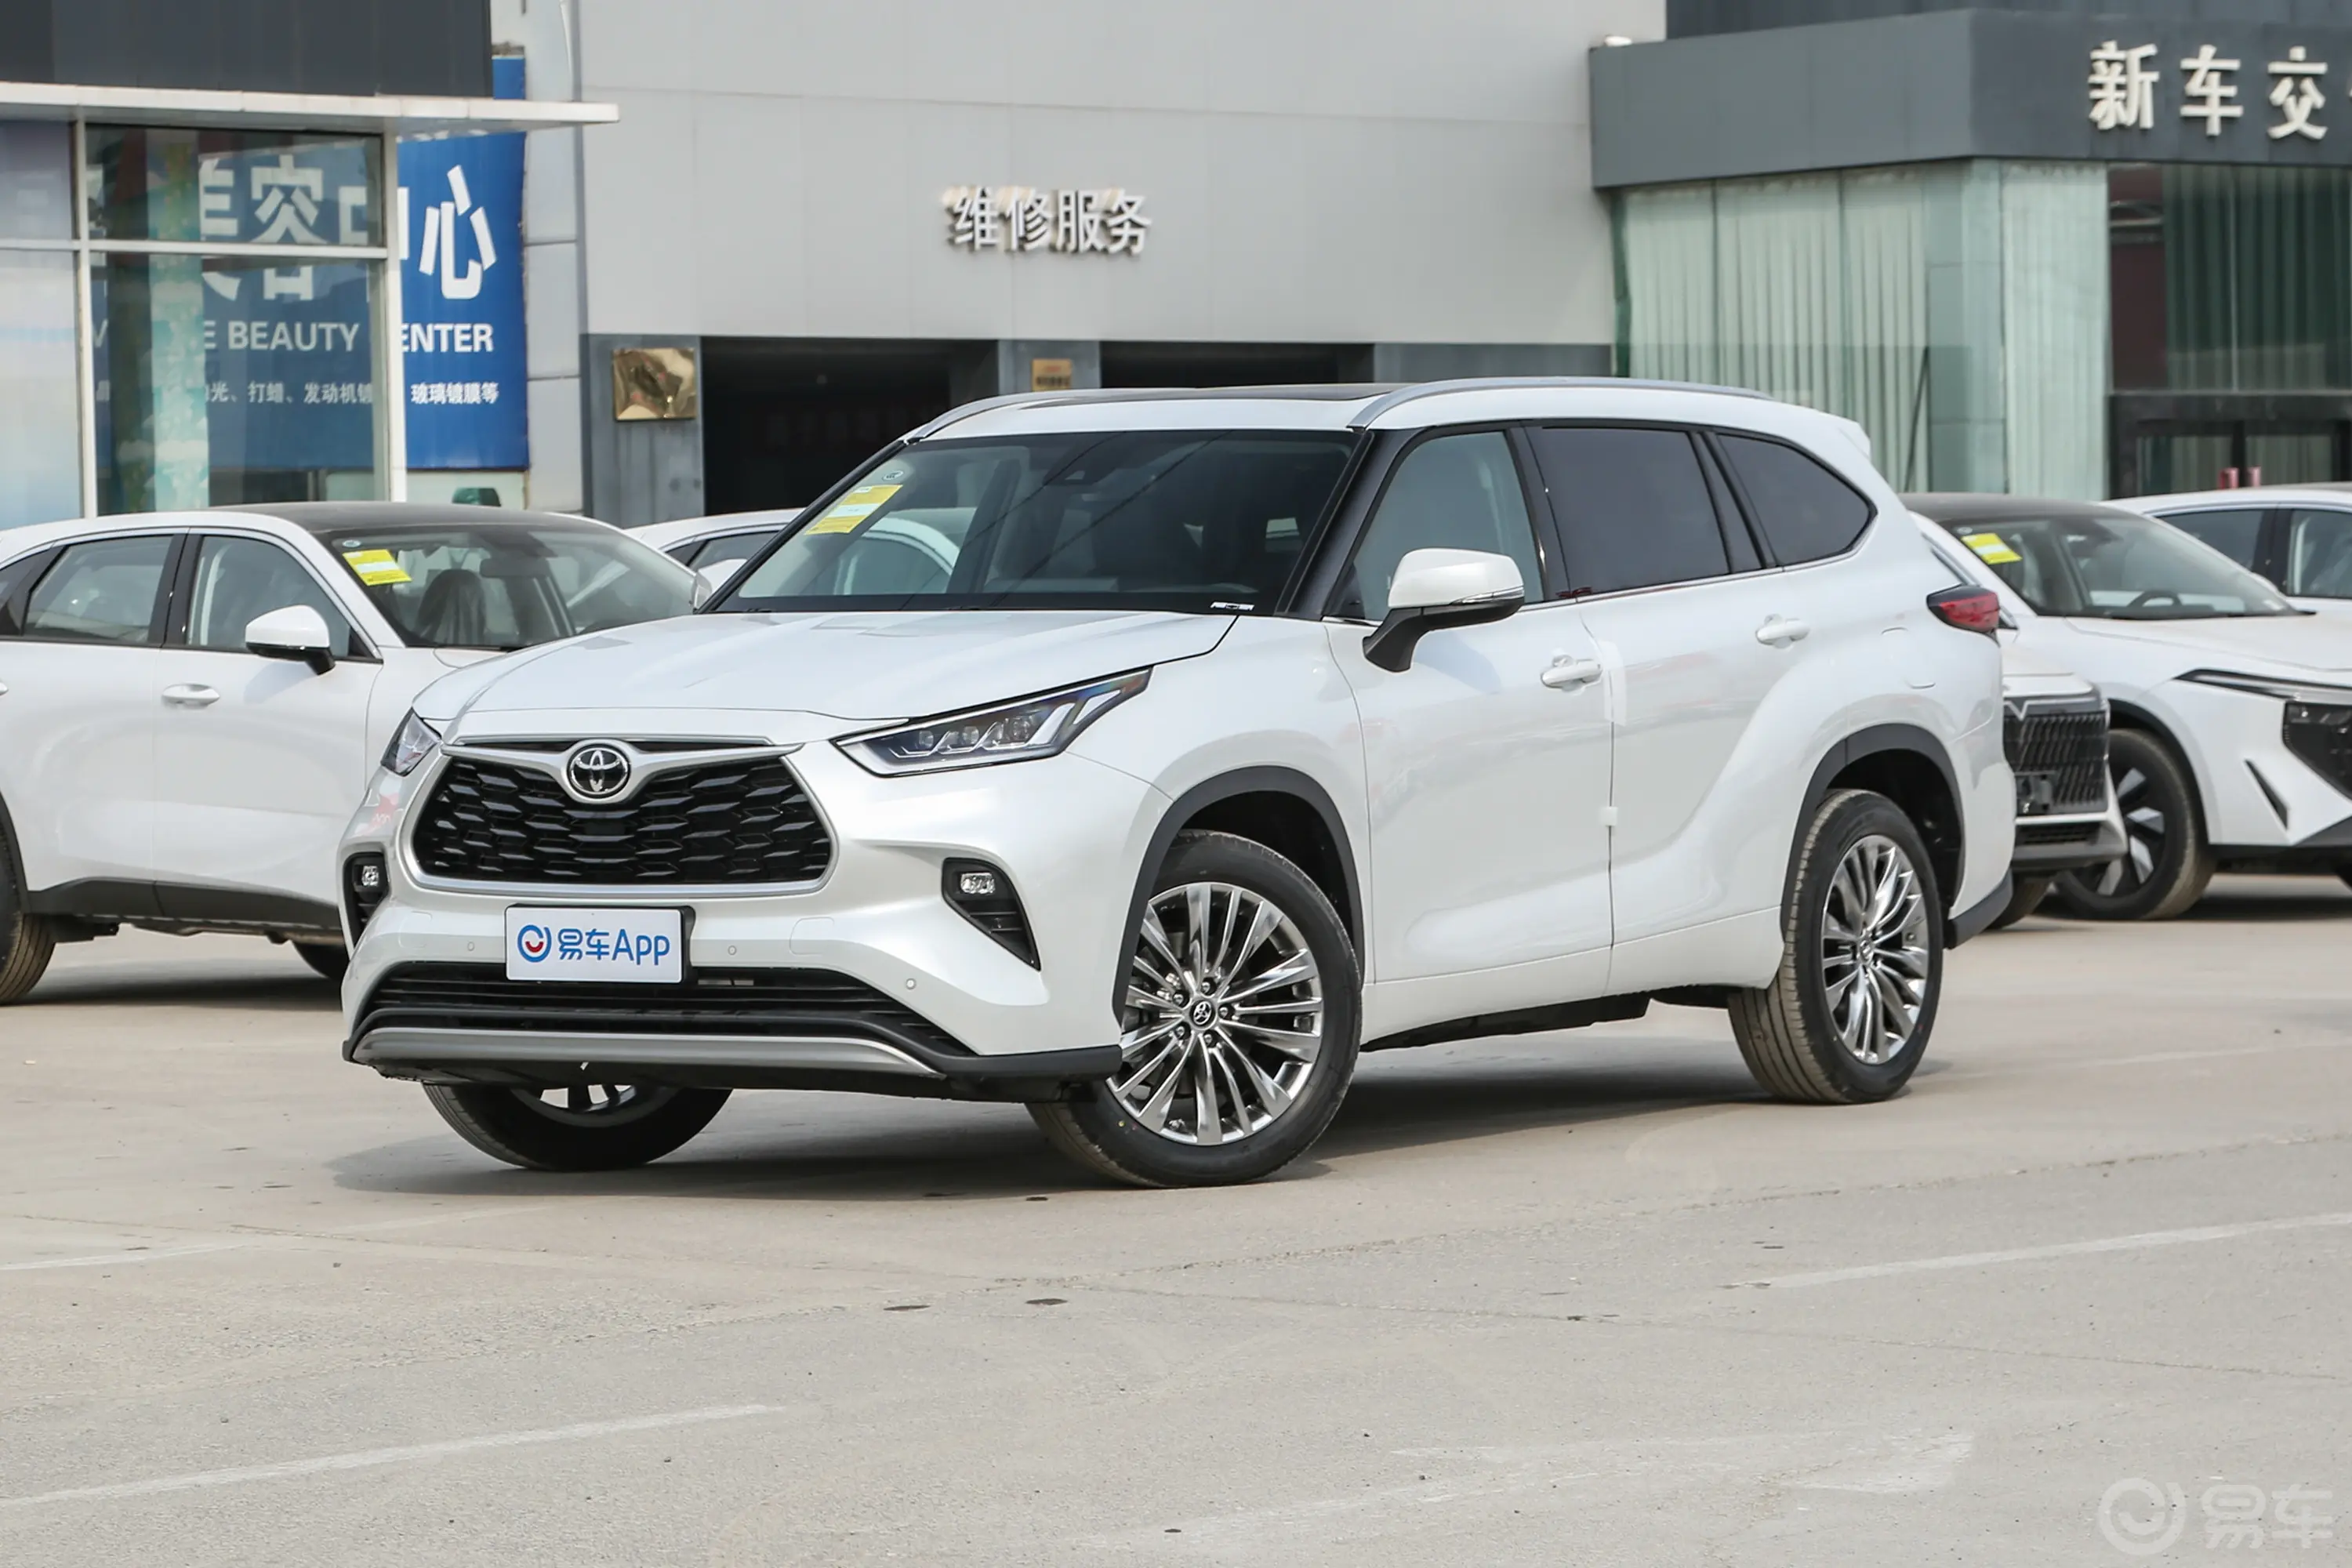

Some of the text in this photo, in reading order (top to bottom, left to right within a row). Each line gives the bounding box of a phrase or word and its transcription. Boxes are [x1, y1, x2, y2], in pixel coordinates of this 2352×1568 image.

[2087, 40, 2352, 140] 新车交
[946, 186, 1153, 255] 维修服务
[227, 320, 360, 351] BEAUTY
[557, 928, 670, 965] 易车App
